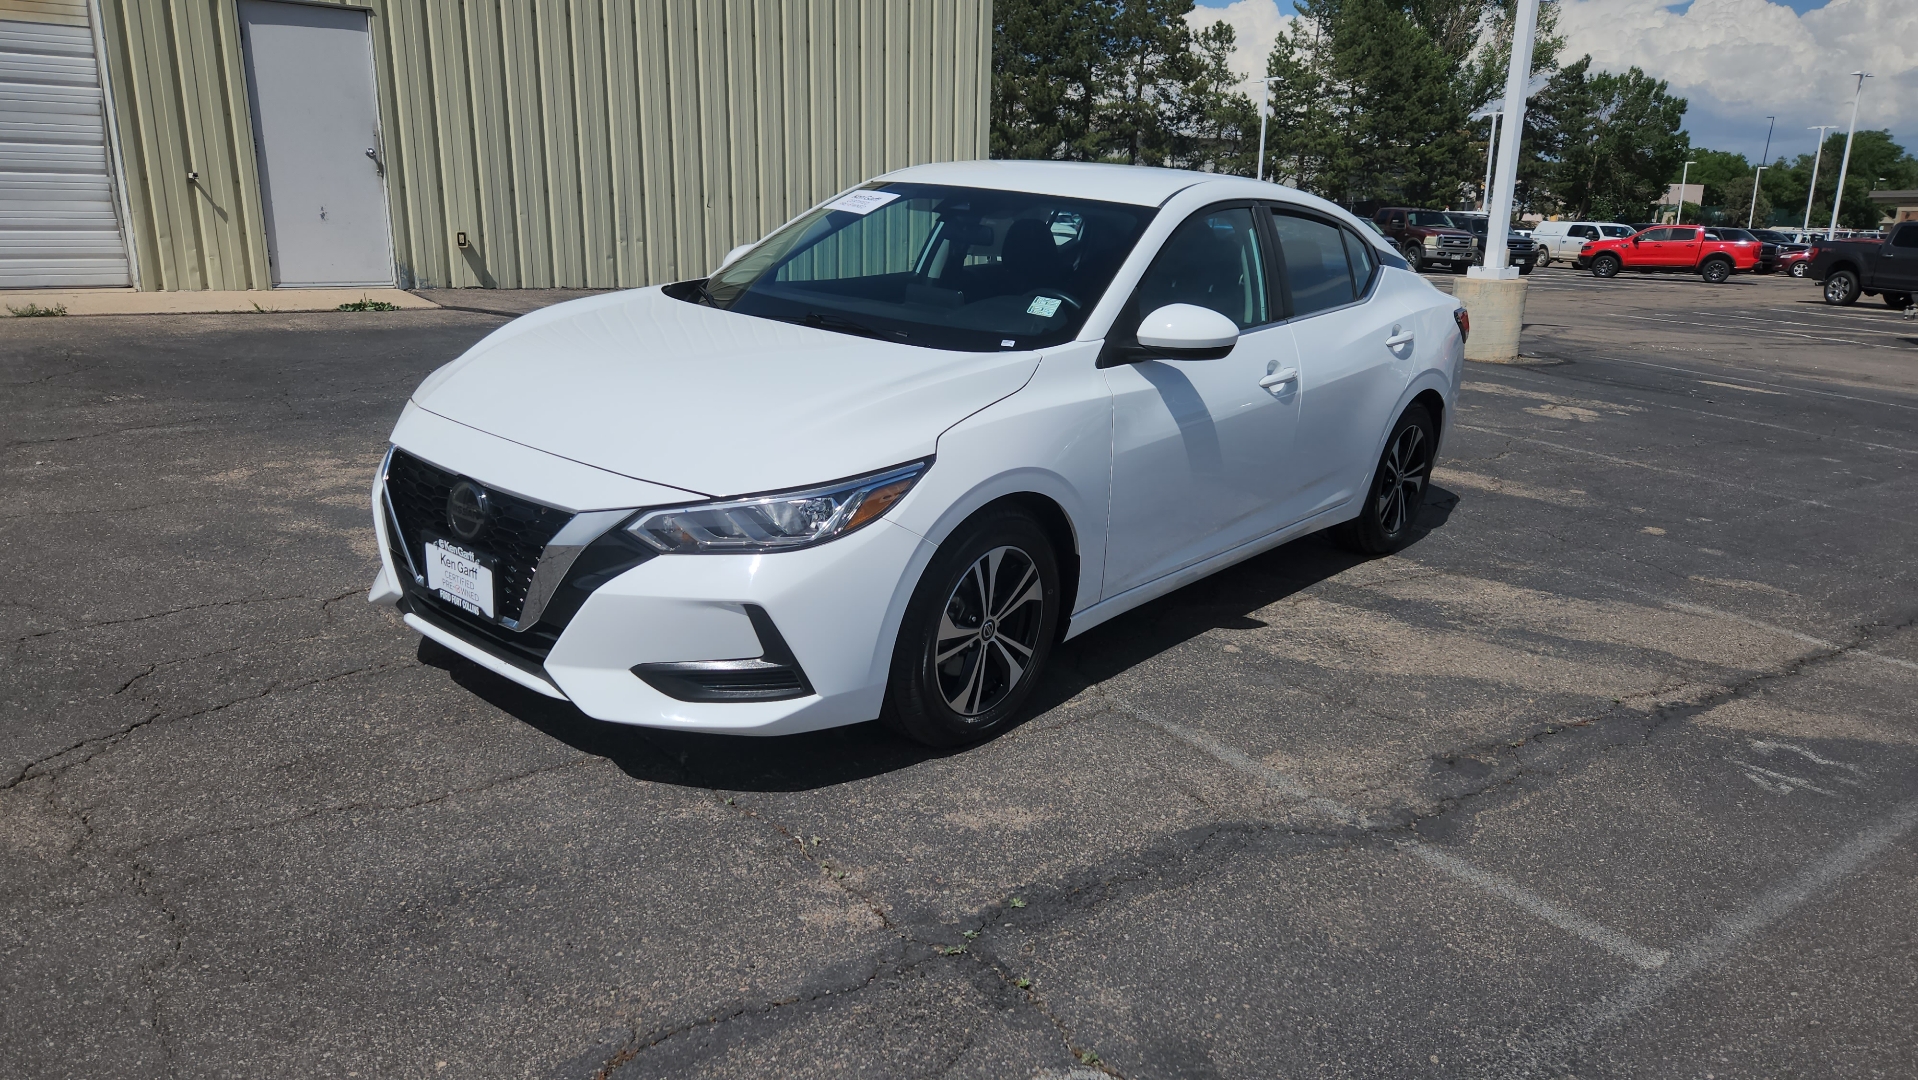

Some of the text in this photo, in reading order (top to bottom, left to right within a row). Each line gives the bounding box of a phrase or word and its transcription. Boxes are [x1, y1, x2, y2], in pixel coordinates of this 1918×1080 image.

[440, 552, 478, 580] Ken Garff
[444, 570, 475, 590] CERTIFIED
